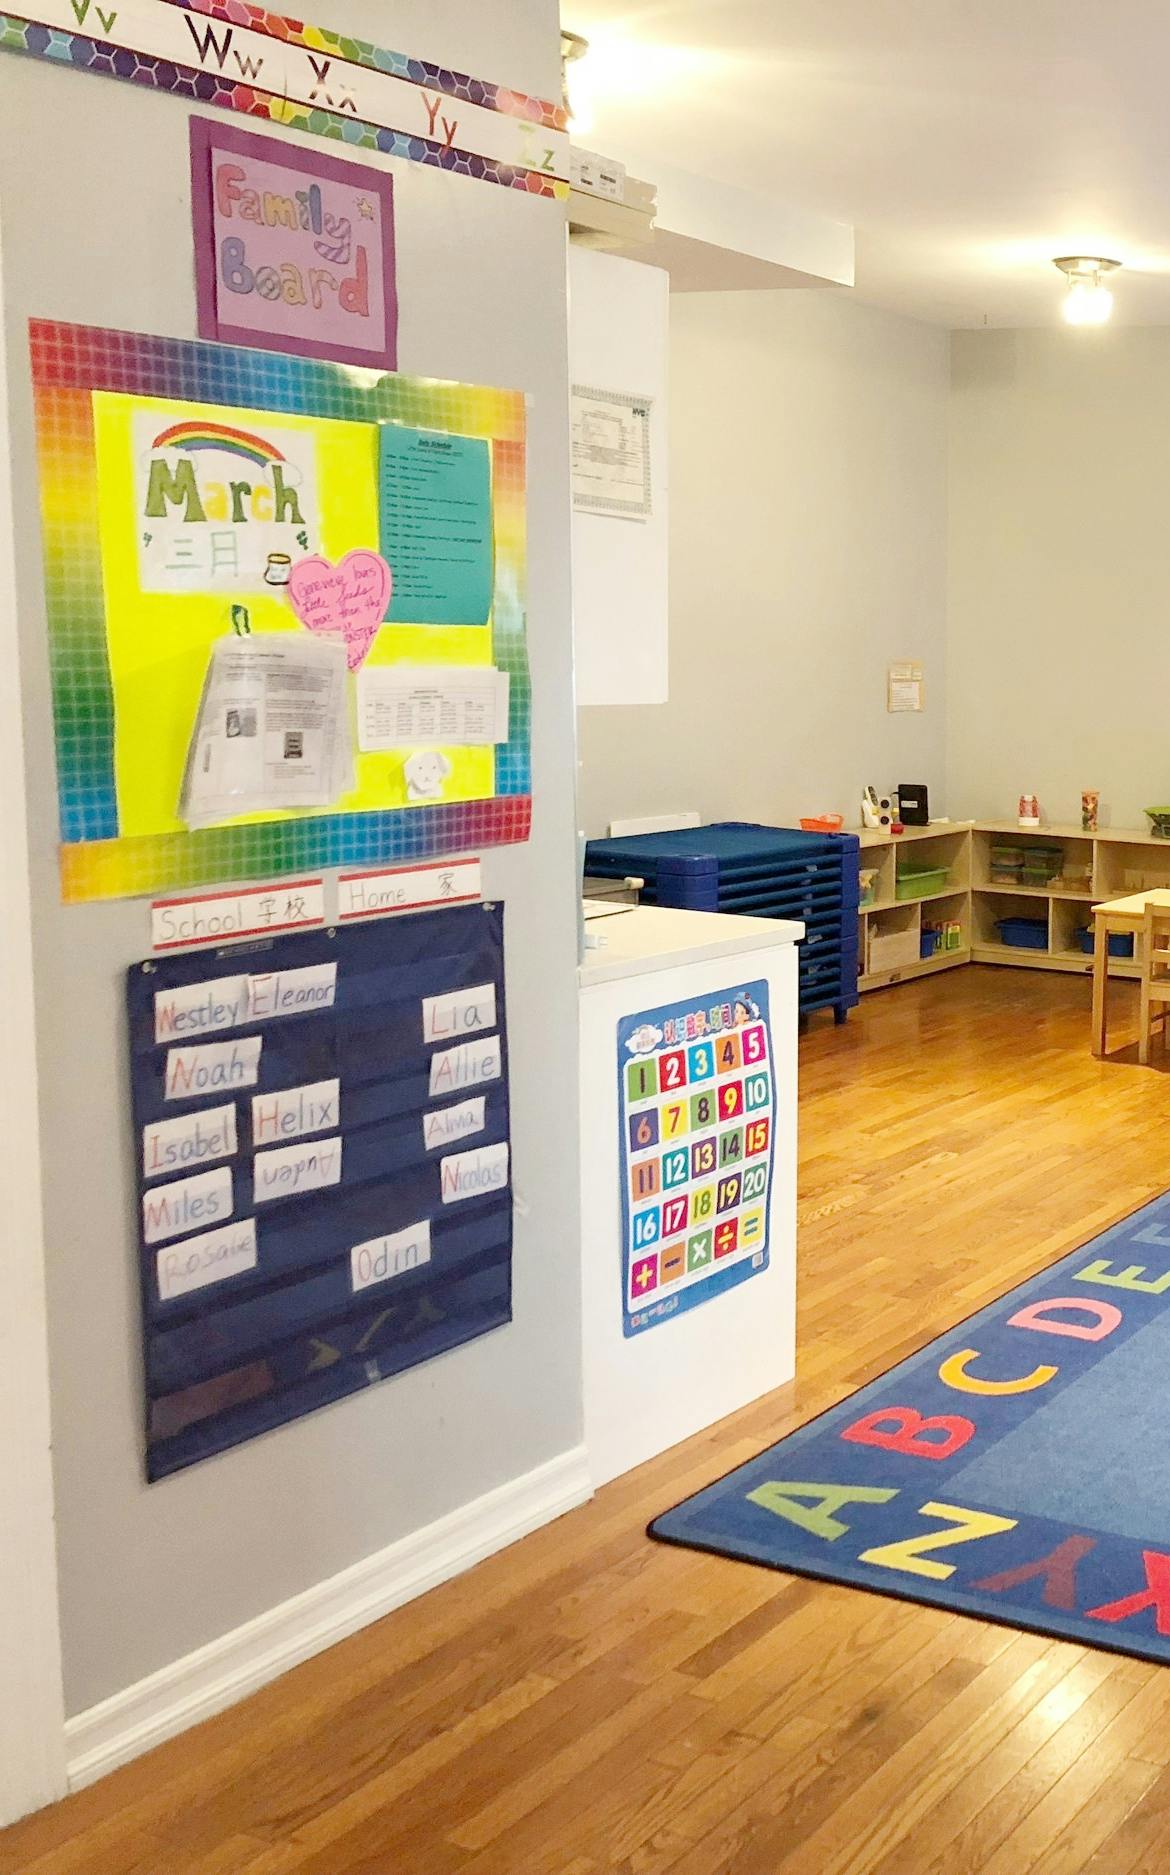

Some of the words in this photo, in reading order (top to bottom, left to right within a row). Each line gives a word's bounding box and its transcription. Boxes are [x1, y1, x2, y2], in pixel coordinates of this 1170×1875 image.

[216, 164, 352, 264] Family
[221, 236, 370, 317] Board
[144, 458, 306, 524] March
[165, 531, 239, 577] 三月
[350, 882, 406, 911] Home
[160, 902, 243, 941] School
[252, 975, 334, 1016] Eleanor
[432, 1003, 483, 1035] Lia
[171, 1047, 243, 1093] Noah
[434, 1045, 497, 1085] Allie
[640, 1066, 646, 1094] 1
[665, 1057, 682, 1086] 2
[694, 1048, 708, 1077] 3
[722, 1040, 735, 1066] 4
[747, 1031, 761, 1060] 5
[259, 1093, 333, 1138] Helix
[427, 1110, 479, 1140] Alma
[636, 1116, 652, 1145] 6
[668, 1106, 682, 1134] 7
[697, 1097, 710, 1123] 8
[724, 1087, 738, 1115] 9
[747, 1078, 767, 1107] 10
[150, 1114, 229, 1169] Isabel
[639, 1165, 654, 1194] 11
[665, 1152, 687, 1184] 12
[694, 1142, 714, 1174] 13
[722, 1133, 741, 1162] 14
[748, 1122, 767, 1152] 15
[442, 1156, 502, 1195] Nicolas
[144, 1189, 220, 1229] Miles
[635, 1212, 657, 1245] 16
[665, 1199, 686, 1233] 17
[692, 1189, 712, 1220] 18
[719, 1178, 739, 1208] 19
[744, 1167, 766, 1197] 20
[358, 1240, 418, 1282] Odin
[745, 1479, 902, 1542] A
[839, 1406, 977, 1461] B
[938, 1348, 1060, 1396] C
[1005, 1296, 1123, 1342] D
